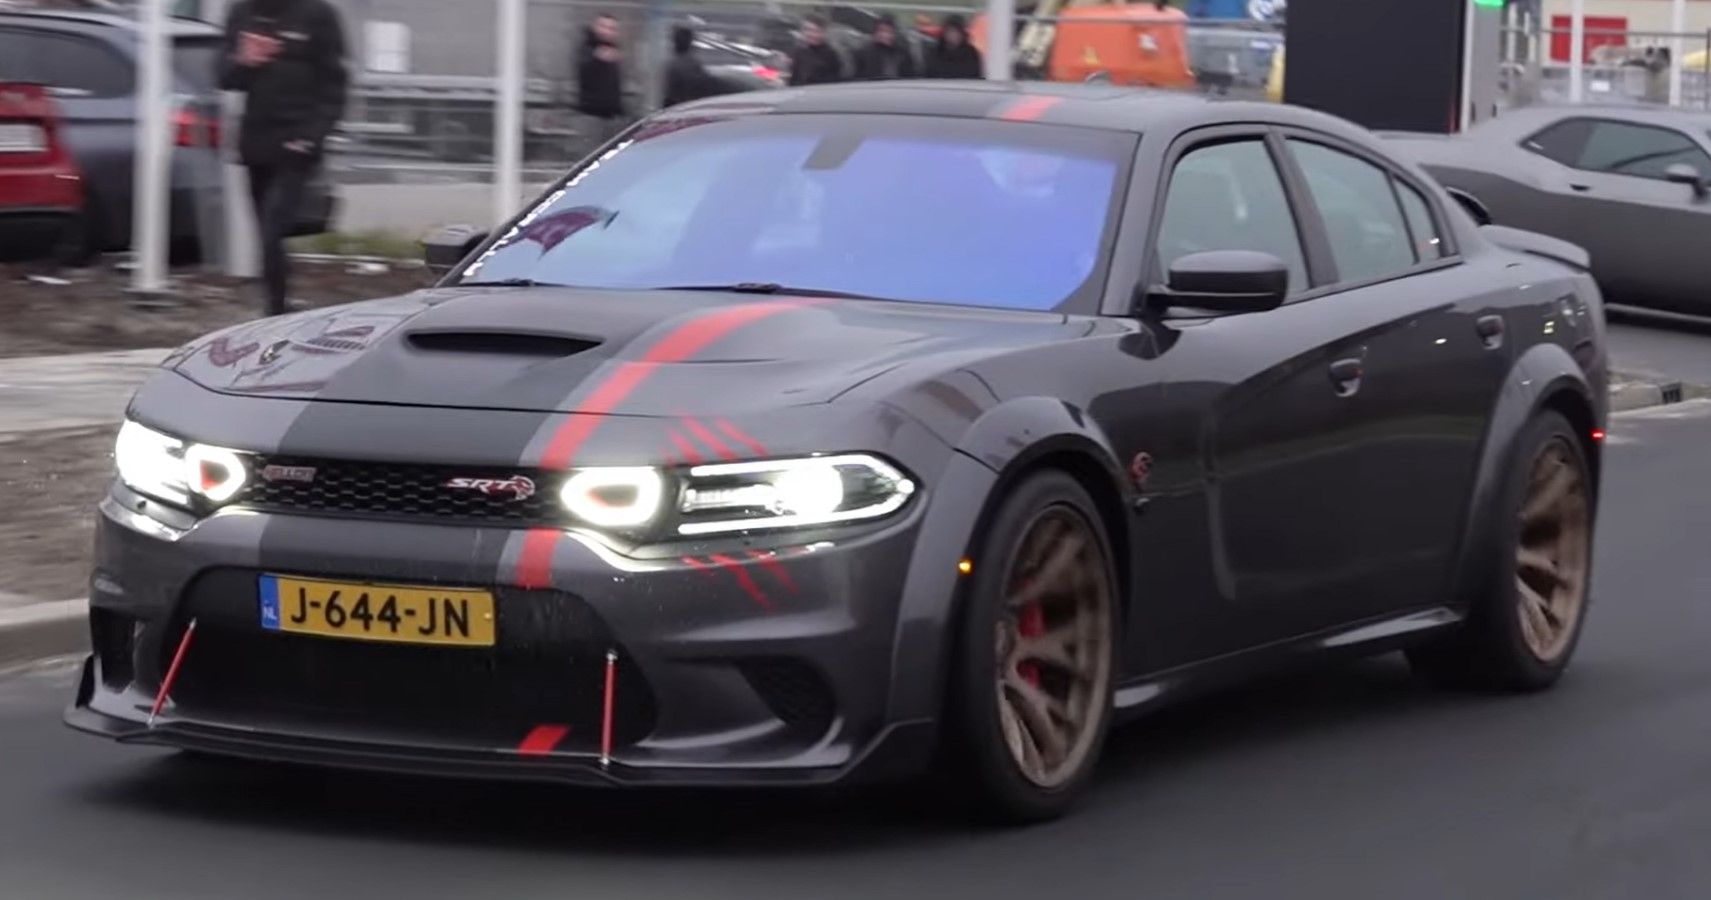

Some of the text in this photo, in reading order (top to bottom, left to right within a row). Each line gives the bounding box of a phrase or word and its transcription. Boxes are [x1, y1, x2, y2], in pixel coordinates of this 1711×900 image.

[447, 477, 517, 495] SRT
[263, 587, 469, 637] NL J-644-JN
